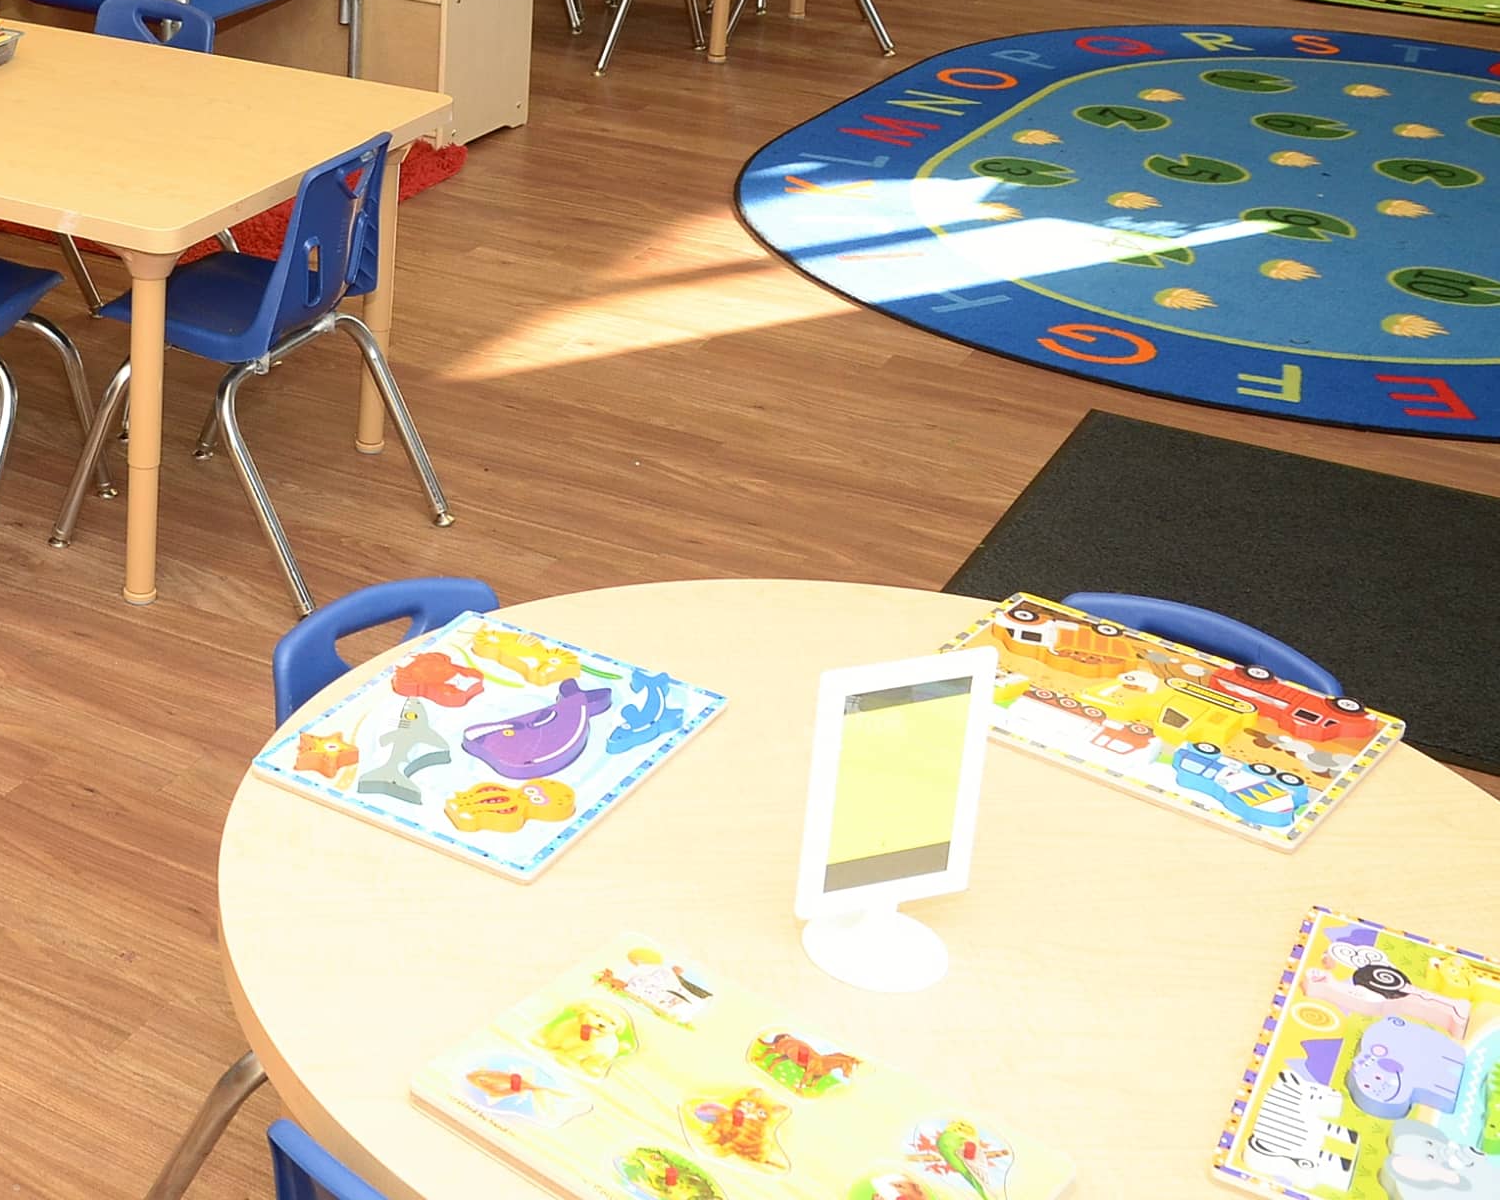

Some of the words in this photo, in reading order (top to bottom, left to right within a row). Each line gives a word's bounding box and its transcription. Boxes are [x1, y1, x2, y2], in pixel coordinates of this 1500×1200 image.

[1075, 34, 1166, 57] Q
[1181, 32, 1253, 52] R
[1290, 34, 1342, 56] S
[1392, 43, 1437, 64] T
[989, 50, 1056, 70] P
[936, 67, 1020, 91] O
[885, 89, 983, 117] N
[837, 114, 941, 148] M
[797, 152, 891, 169] L
[1402, 162, 1456, 180] 8
[784, 175, 875, 199] K
[1037, 322, 1158, 365] G
[1236, 364, 1302, 403] F
[1375, 373, 1478, 421] E
